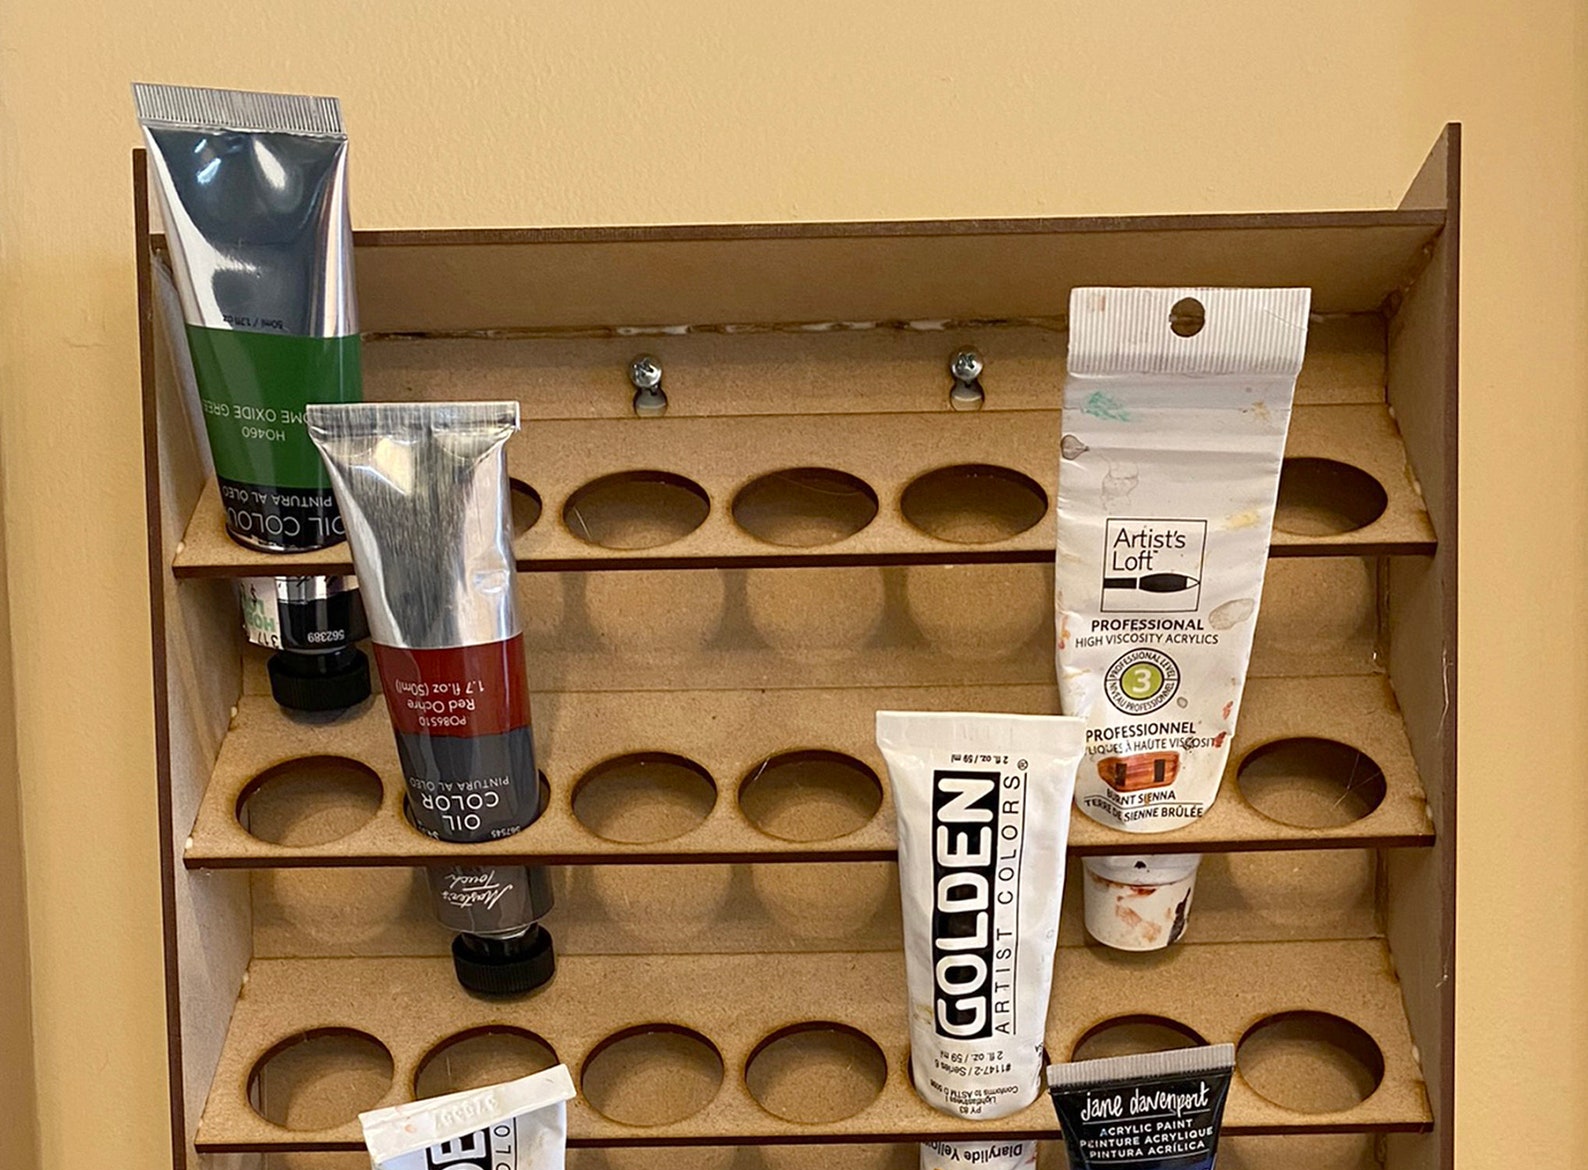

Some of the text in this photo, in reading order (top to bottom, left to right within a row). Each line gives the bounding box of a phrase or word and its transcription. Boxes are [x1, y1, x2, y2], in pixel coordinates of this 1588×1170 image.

[203, 399, 277, 422] OXIDE GREE
[251, 491, 267, 502] AL
[271, 495, 332, 508] PINTURA
[228, 507, 345, 537] OIL COLOU
[1113, 527, 1186, 549] Artist's
[1112, 550, 1154, 571] Loft
[1091, 618, 1204, 632] PROFESSIONAL
[307, 629, 345, 643] 562389
[1075, 633, 1219, 649] HIGH VISCOSITY ACRYLICS
[1109, 651, 1176, 678] PROFESSIONAL LEVEL
[395, 679, 429, 697] (50ml)
[466, 680, 485, 694] 1.7
[1132, 668, 1152, 693] 3
[1109, 681, 1176, 712] NIVEAU PROFESSIONNEL
[407, 698, 476, 714] Red Ochre
[1086, 721, 1196, 743] PROFESSIONNEL
[1134, 738, 1168, 752] HAUTE
[1169, 736, 1215, 750] VISCOSIT
[951, 753, 962, 763] ml
[963, 754, 974, 764] 59
[981, 754, 992, 763] oz.
[1003, 755, 1009, 765] 2
[441, 781, 455, 791] AL
[457, 775, 510, 791] PINTURA
[420, 791, 499, 812] COLOR
[1107, 788, 1177, 806] BURNT SIENNA
[1084, 799, 1204, 823] TERRE DE SIENNE BRÛLÉE
[442, 813, 481, 831] OIL
[444, 870, 500, 891] Touch
[441, 884, 513, 910] Master's
[995, 775, 1021, 1035] ARTIST COLORS
[935, 777, 996, 1036] GOLDEN
[951, 1052, 964, 1063] 59
[971, 1051, 985, 1061] oz.
[997, 1050, 1004, 1060] 2
[941, 1061, 967, 1077] Series
[974, 1062, 1012, 1077] #1147-2
[950, 1088, 975, 1099] ASTM
[974, 1087, 982, 1097] to
[983, 1085, 1019, 1096] Conforms
[1081, 1081, 1210, 1121] jane davenport
[970, 1106, 982, 1114] PY
[1099, 1118, 1194, 1137] ACRYLIC PAINT
[1079, 1126, 1214, 1149] PEINTURE ACRYLIQUE
[922, 1141, 1023, 1164] Diarylide Yello
[1089, 1140, 1206, 1160] PINTURA ACRÍLICA
